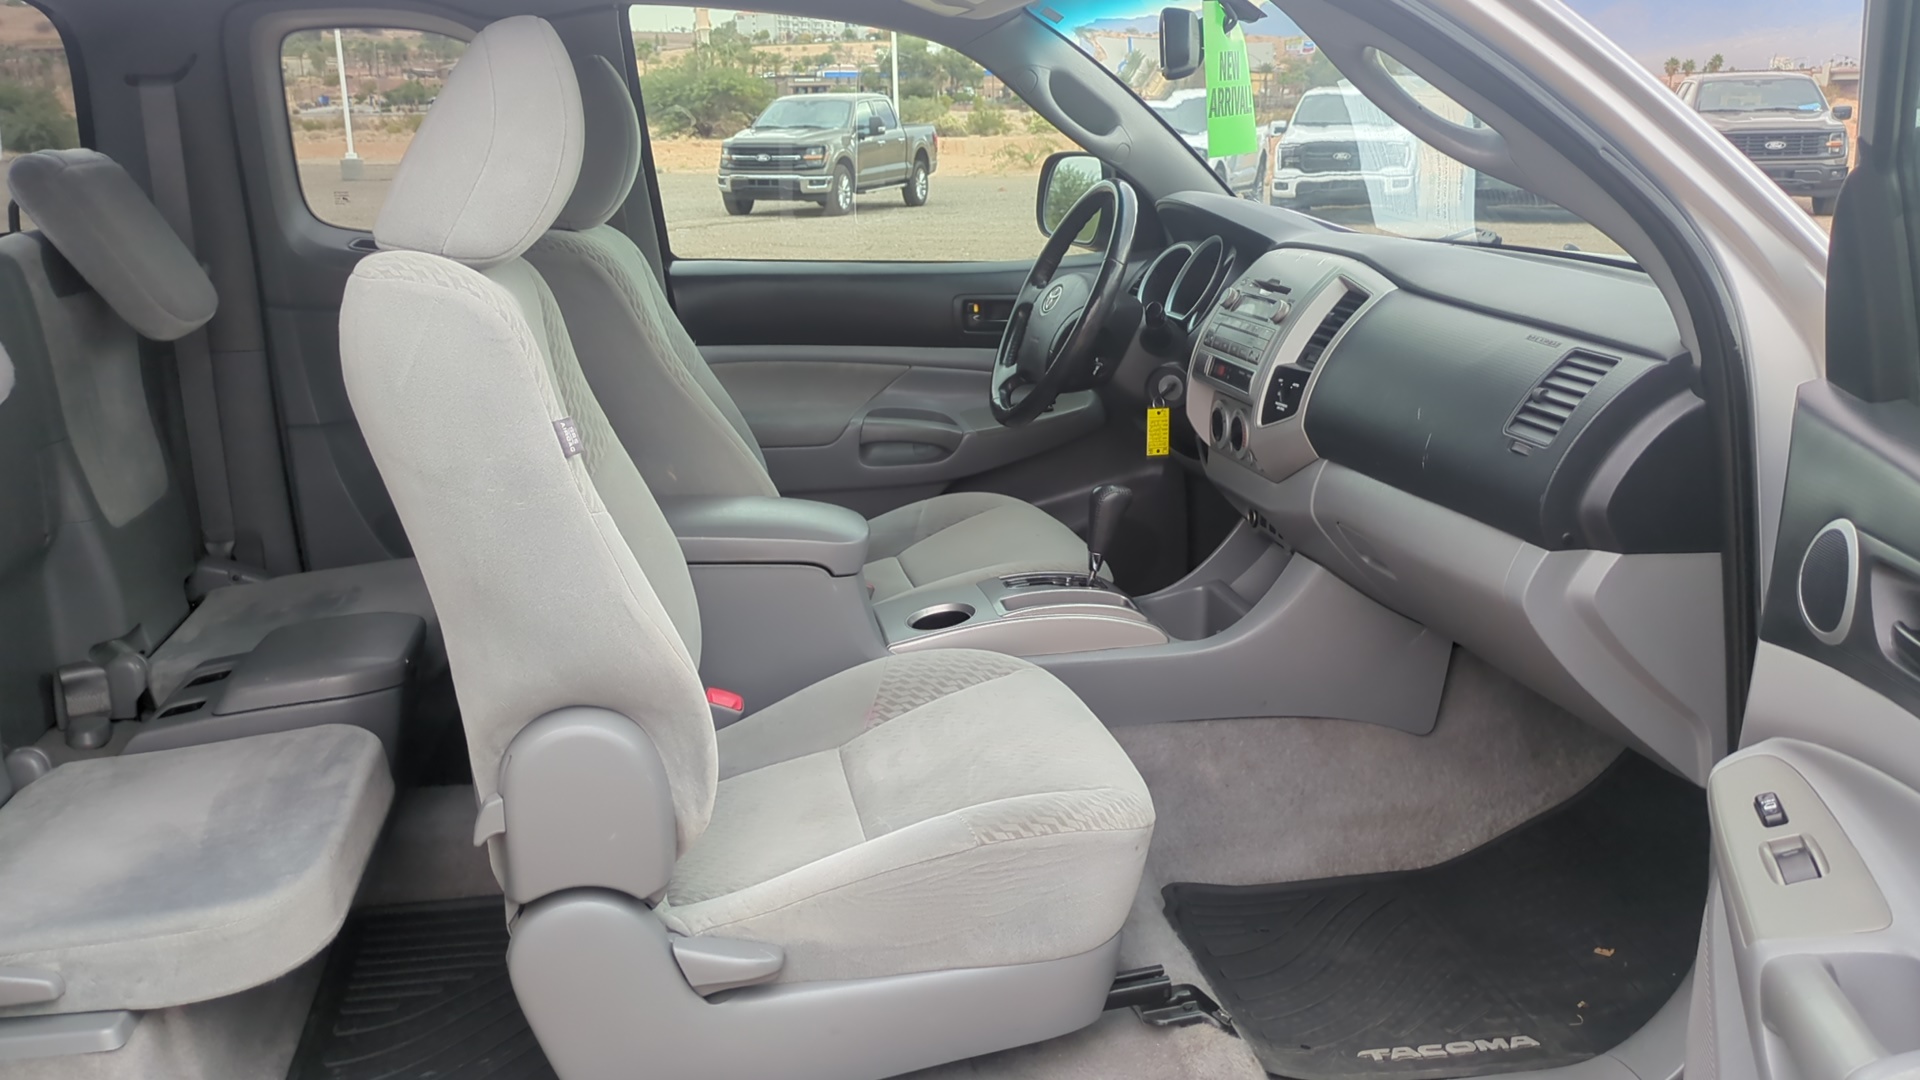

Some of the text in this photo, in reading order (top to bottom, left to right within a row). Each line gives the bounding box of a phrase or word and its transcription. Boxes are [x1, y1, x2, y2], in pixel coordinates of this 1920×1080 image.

[1219, 51, 1240, 81] NEW
[1208, 85, 1252, 118] ARRIVAL!
[1357, 1035, 1540, 1062] TACOMA
